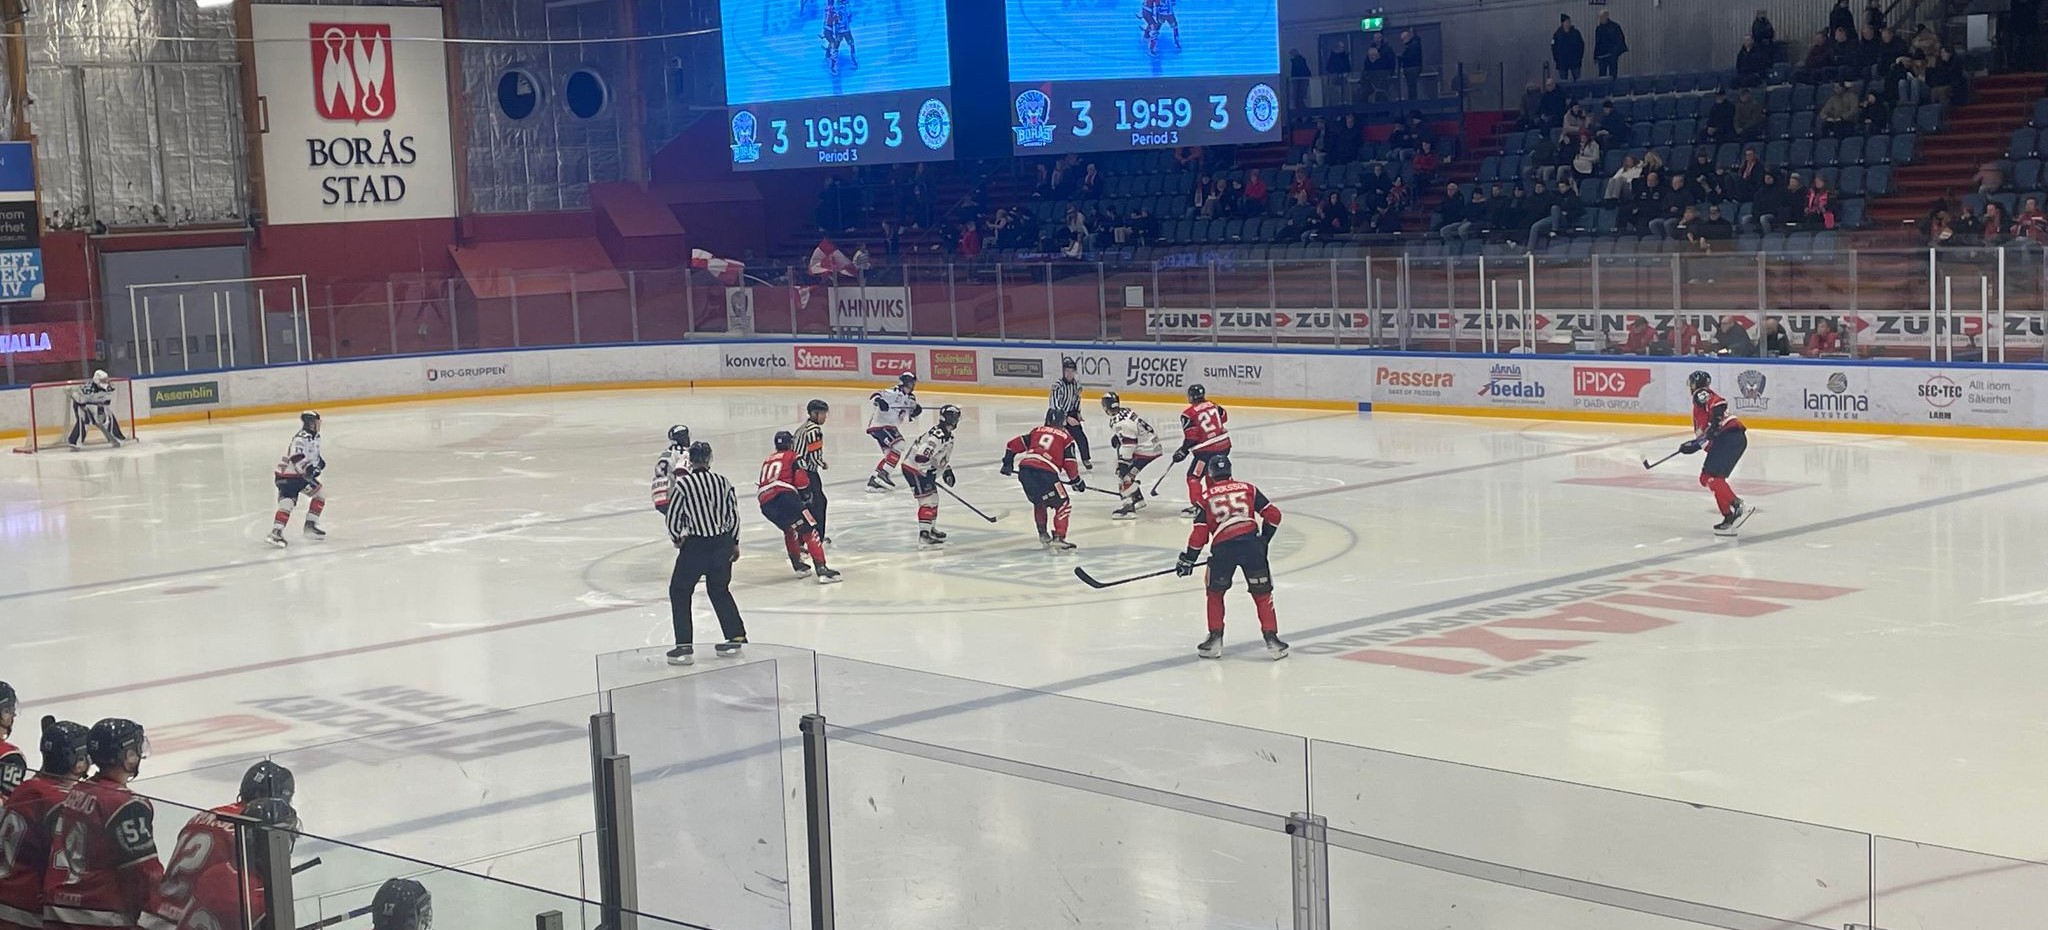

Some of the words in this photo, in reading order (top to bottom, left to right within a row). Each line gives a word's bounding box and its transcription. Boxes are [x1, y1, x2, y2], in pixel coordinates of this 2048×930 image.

[1071, 101, 1094, 136] 3
[1115, 98, 1192, 130] 19:59
[1208, 95, 1229, 129] 3
[771, 120, 789, 154] 3
[804, 115, 868, 148] 19:59
[883, 111, 902, 147] 3
[1131, 133, 1166, 146] Period
[1170, 132, 1178, 144] 3
[306, 128, 417, 166] BORÅS
[818, 150, 849, 163] Period
[851, 149, 857, 161] 3
[322, 174, 406, 205] STAD
[1, 265, 39, 281] EKT
[725, 354, 787, 368] konverta
[876, 359, 912, 370] CCM
[1128, 357, 1187, 377] HOCKEY
[440, 367, 506, 378] RO-GRUPPEN
[1140, 373, 1183, 387] STORE
[1376, 367, 1454, 387] Passera
[1577, 372, 1625, 392] iPDG
[155, 387, 214, 402] Assemblin
[1490, 381, 1545, 398] bedab
[1969, 380, 1985, 390] Allt
[1987, 382, 2011, 391] inom
[1607, 400, 1640, 409] GROUP
[1804, 388, 1868, 412] lamina
[1968, 394, 2012, 405] Säkerhet
[1198, 408, 1222, 433] 27
[1813, 411, 1859, 420] SYSTEM
[1039, 434, 1054, 450] 9
[761, 460, 783, 484] 10
[1209, 490, 1249, 523] 55
[1290, 583, 1630, 655] STORMARKNAD
[1332, 573, 1866, 675] MAXI
[121, 818, 152, 843] 54
